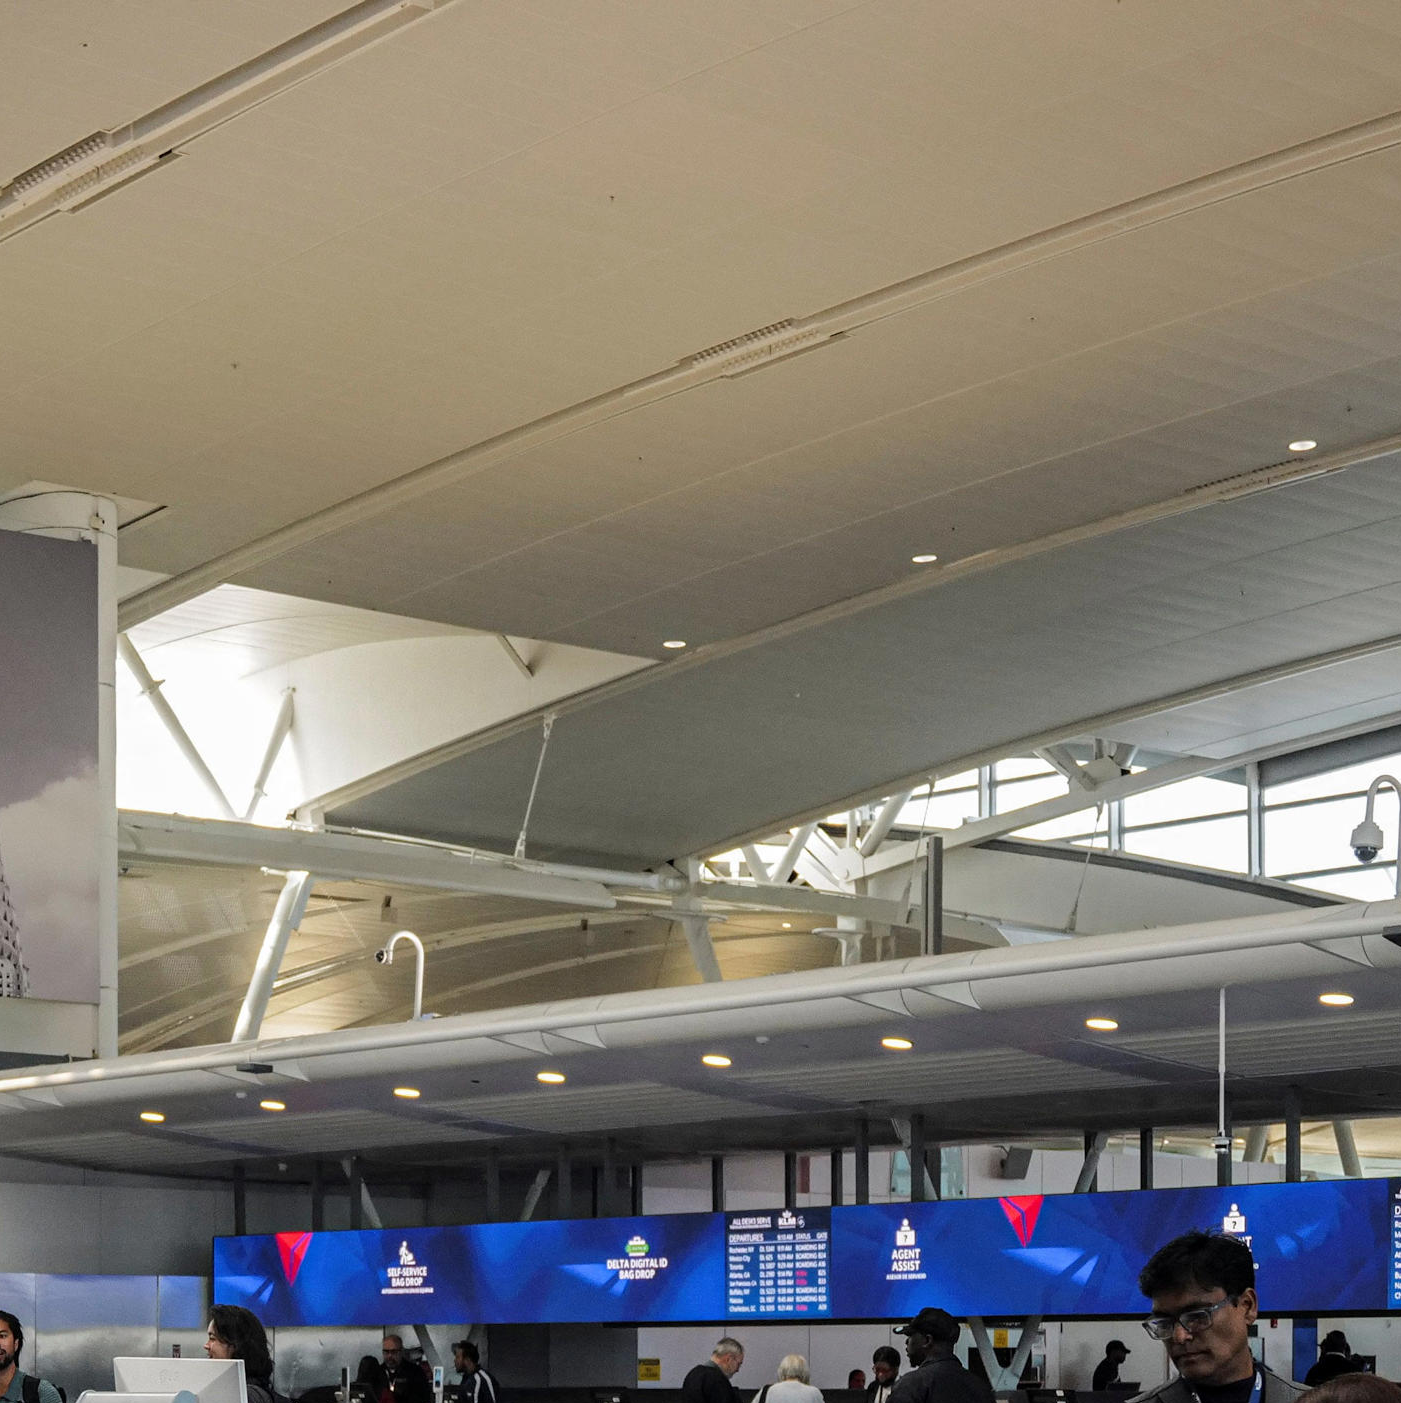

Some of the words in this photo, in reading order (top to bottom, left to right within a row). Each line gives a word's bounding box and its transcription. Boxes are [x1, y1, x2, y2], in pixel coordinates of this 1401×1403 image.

[892, 1248, 920, 1260] AGENT
[607, 1259, 629, 1269] DELTA
[630, 1258, 658, 1268] DIGITAL
[659, 1258, 668, 1268] ID
[892, 1260, 920, 1271] ASSIST
[388, 1266, 427, 1277] SELF-SERVICE
[619, 1270, 634, 1279] BAG
[635, 1270, 655, 1279] DROP
[392, 1278, 404, 1287] BAG
[406, 1277, 423, 1286] DROP
